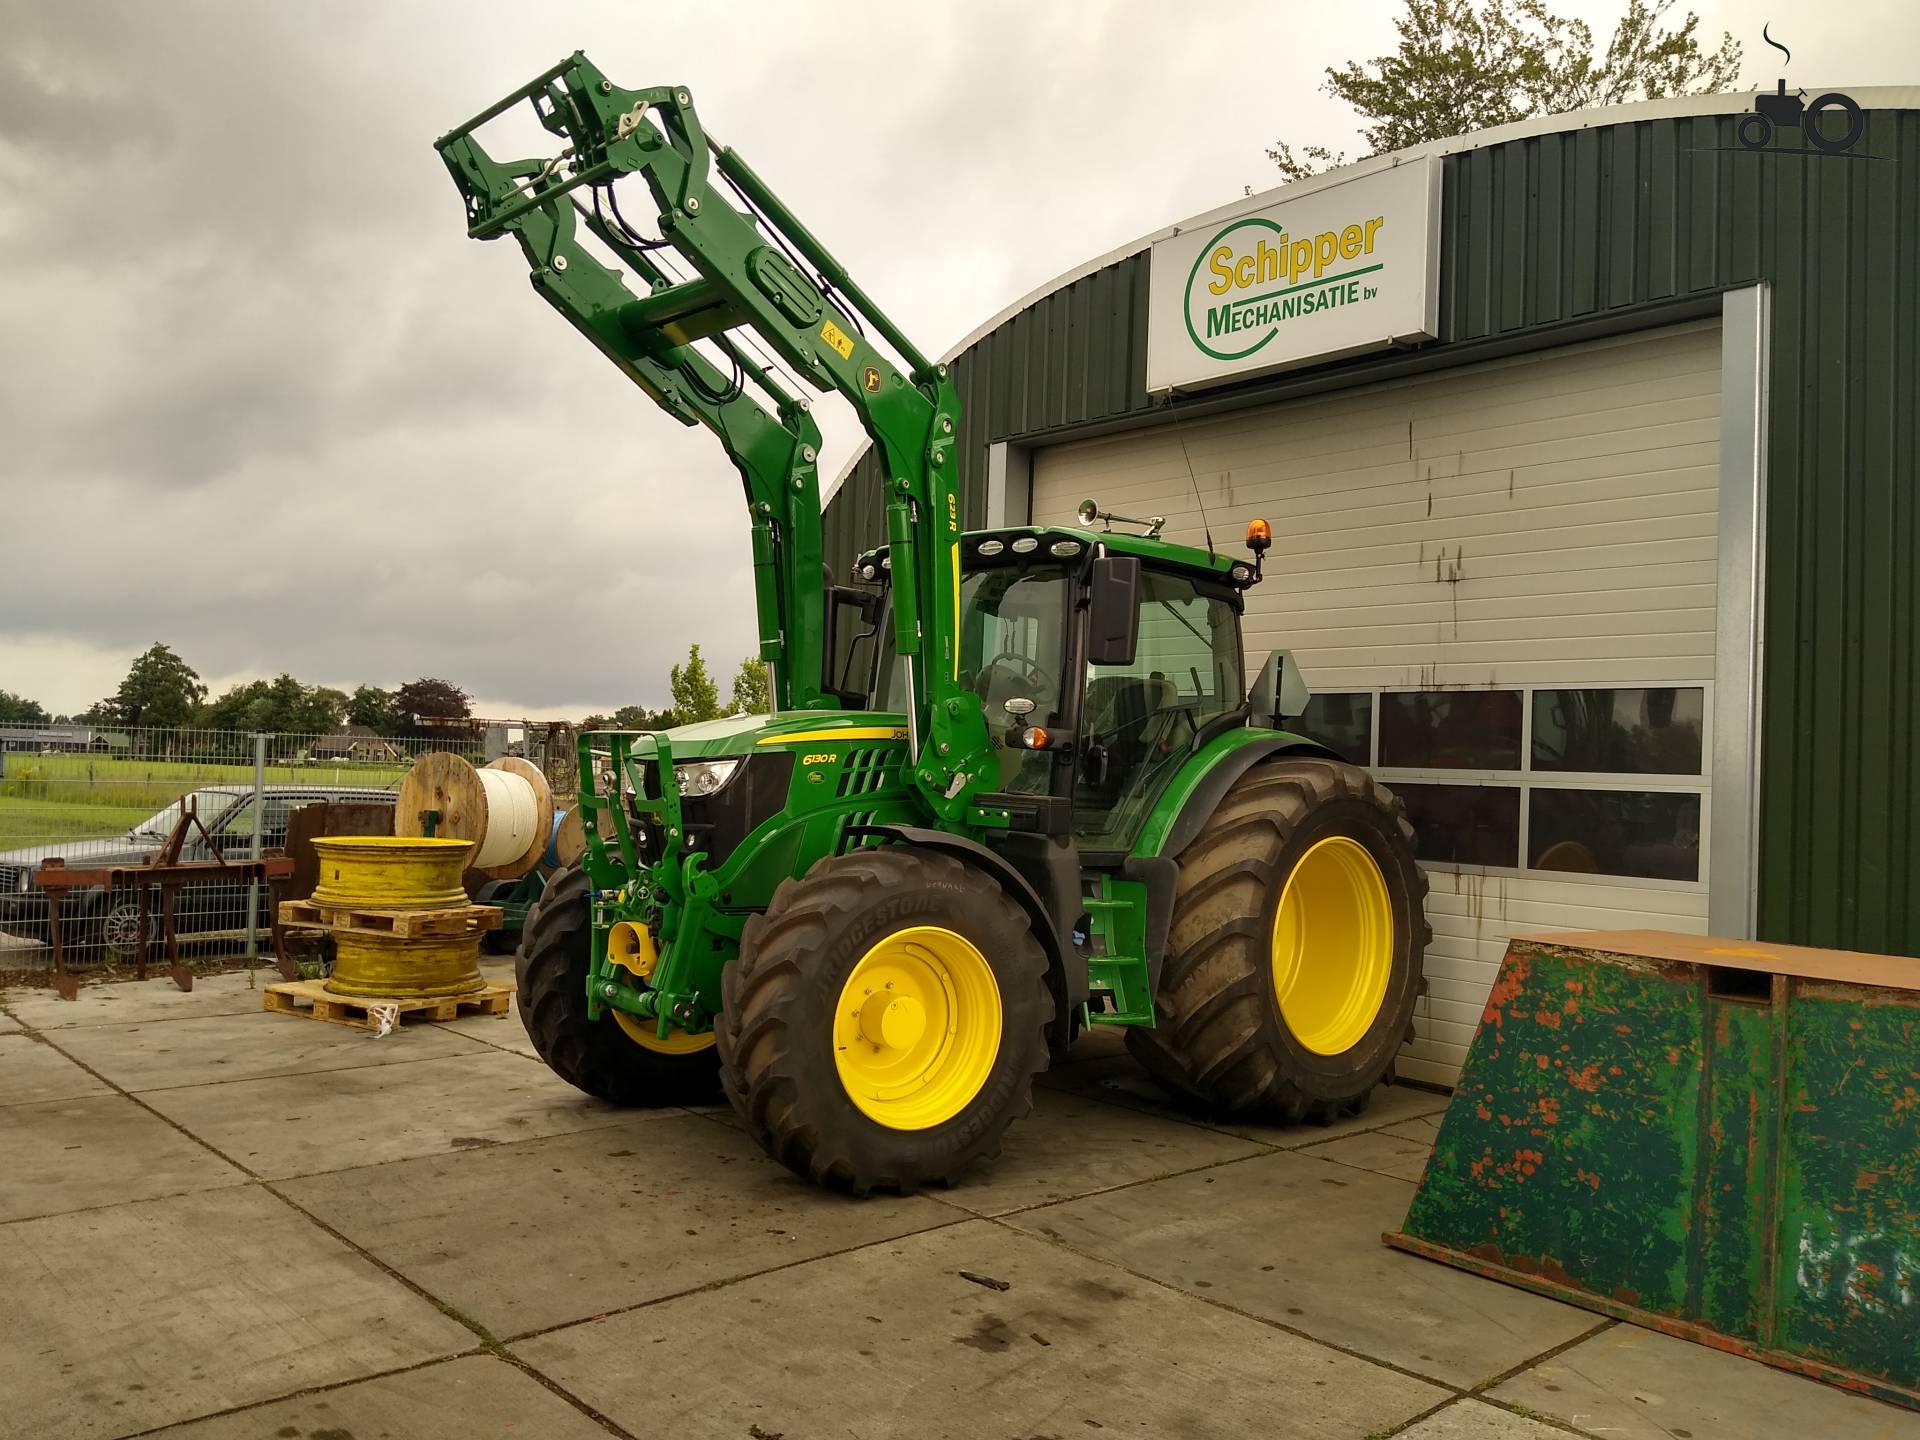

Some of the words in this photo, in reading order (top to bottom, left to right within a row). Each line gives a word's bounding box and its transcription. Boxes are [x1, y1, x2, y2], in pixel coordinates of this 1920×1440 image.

[1208, 216, 1384, 296] Schipper
[1207, 281, 1360, 338] MECHANISATIE
[1363, 286, 1378, 301] bv
[891, 728, 909, 739] JOH
